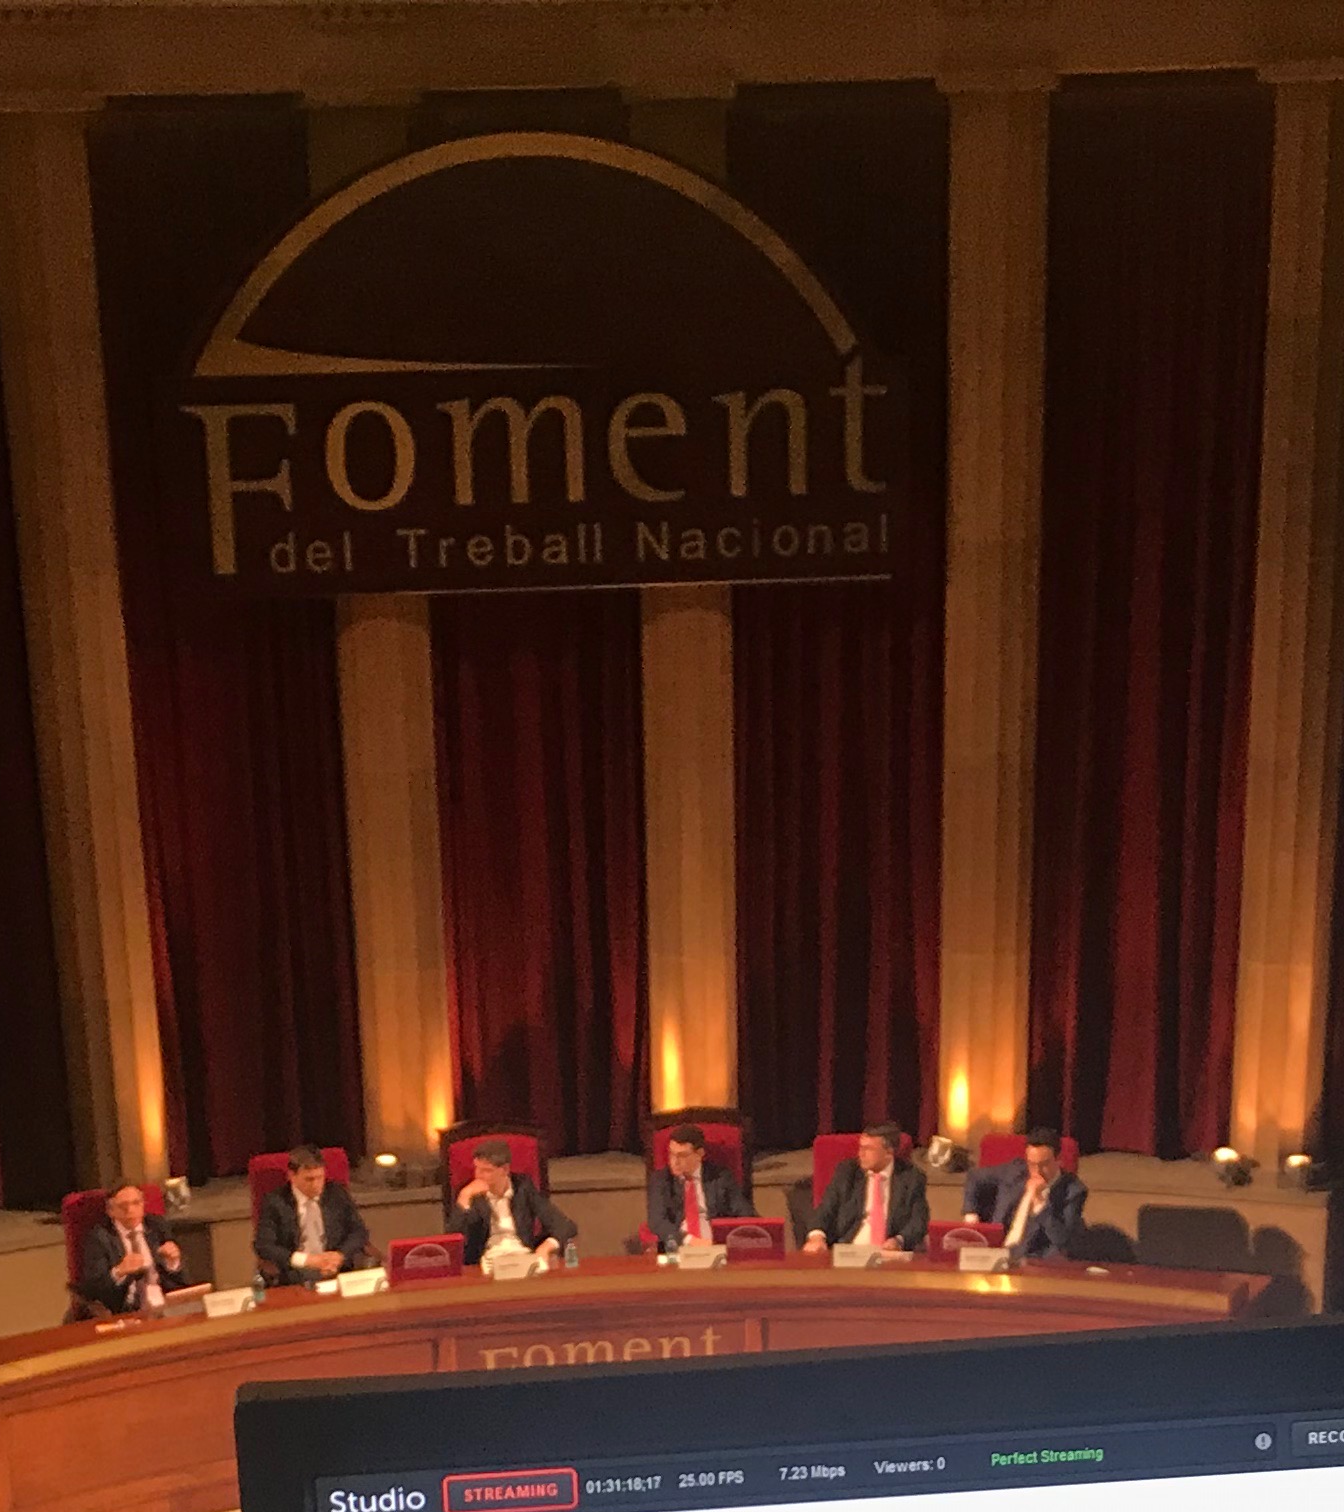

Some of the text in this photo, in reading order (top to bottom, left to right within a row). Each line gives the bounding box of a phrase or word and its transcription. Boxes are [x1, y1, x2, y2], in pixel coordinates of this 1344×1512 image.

[179, 354, 889, 576] Foment
[270, 511, 891, 574] del Treball Nacional
[478, 1324, 723, 1371] Foment
[873, 1457, 946, 1474] Viewers: 0
[990, 1444, 1104, 1467] Perfect Streaming
[678, 1470, 745, 1489] 25.00 FPS
[779, 1464, 846, 1482] 7.23 Mbps
[463, 1482, 558, 1503] STREAMING
